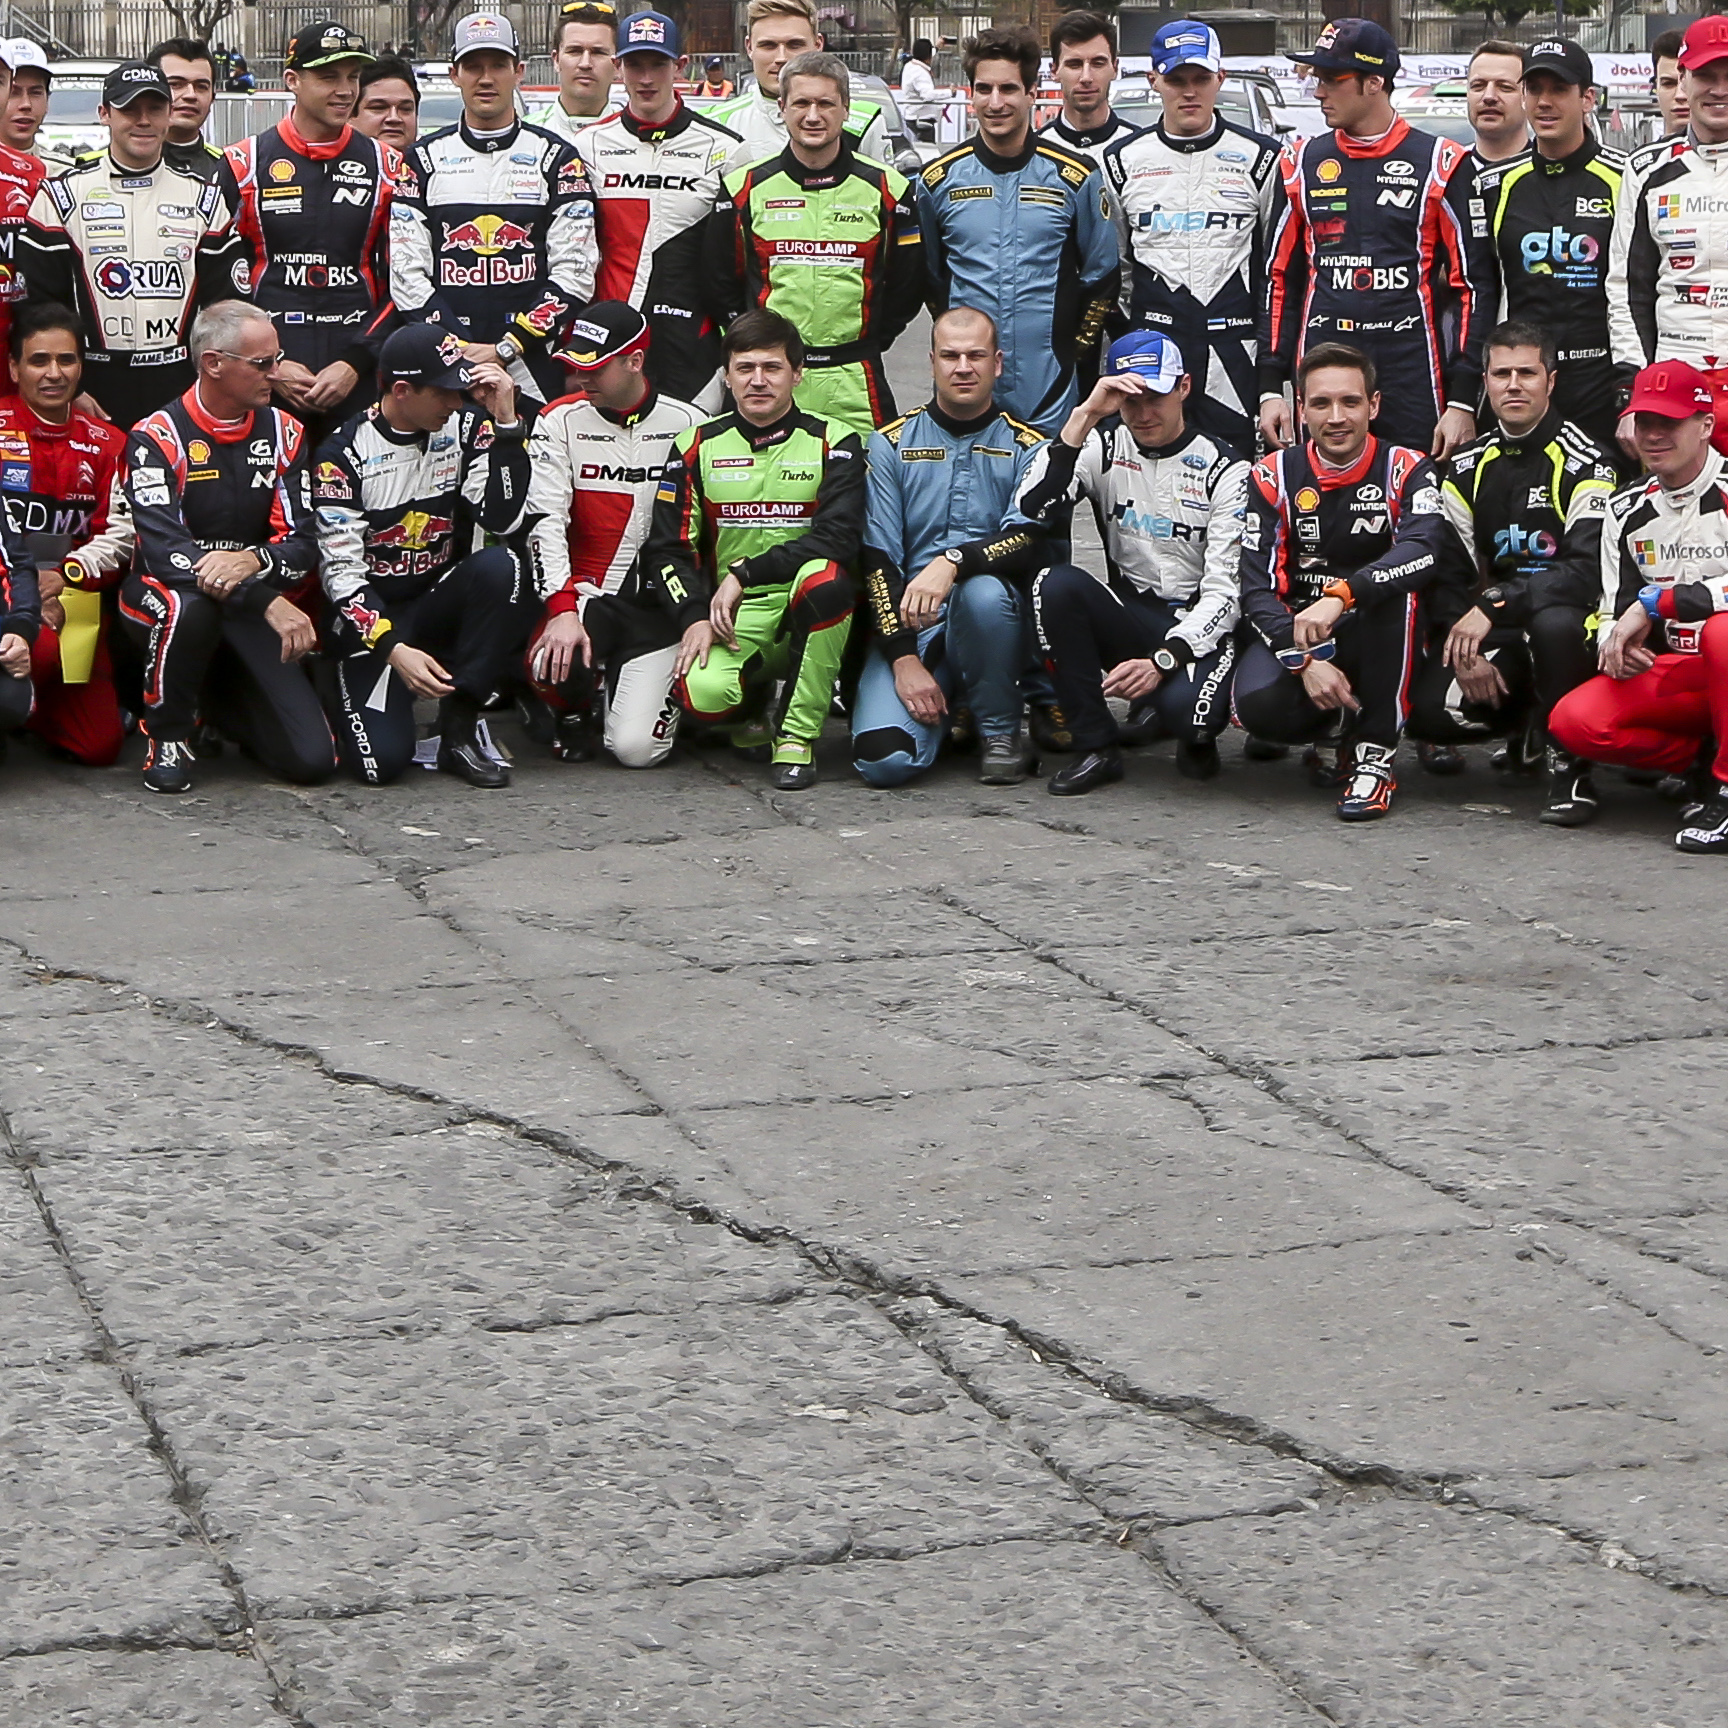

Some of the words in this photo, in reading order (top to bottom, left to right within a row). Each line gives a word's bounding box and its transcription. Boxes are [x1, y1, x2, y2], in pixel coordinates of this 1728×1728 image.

[122, 68, 159, 82] CDMX
[603, 174, 701, 193] DMACK
[833, 212, 864, 223] Turbo
[776, 241, 857, 255] EUROLAMP
[1520, 226, 1600, 275] gto
[274, 253, 327, 265] HYUNDAI
[1320, 255, 1372, 267] HYUNDAI
[284, 265, 359, 287] MOBIS
[440, 257, 487, 286] Red
[490, 253, 537, 285] Bull
[1332, 266, 1410, 290] MOBIS
[580, 464, 667, 483] DMAC
[710, 471, 751, 482] LED
[780, 469, 815, 481] Turbo
[721, 504, 805, 517] EUROLAMP
[1389, 553, 1435, 579] HYUNDAI
[1192, 682, 1218, 726] FORD
